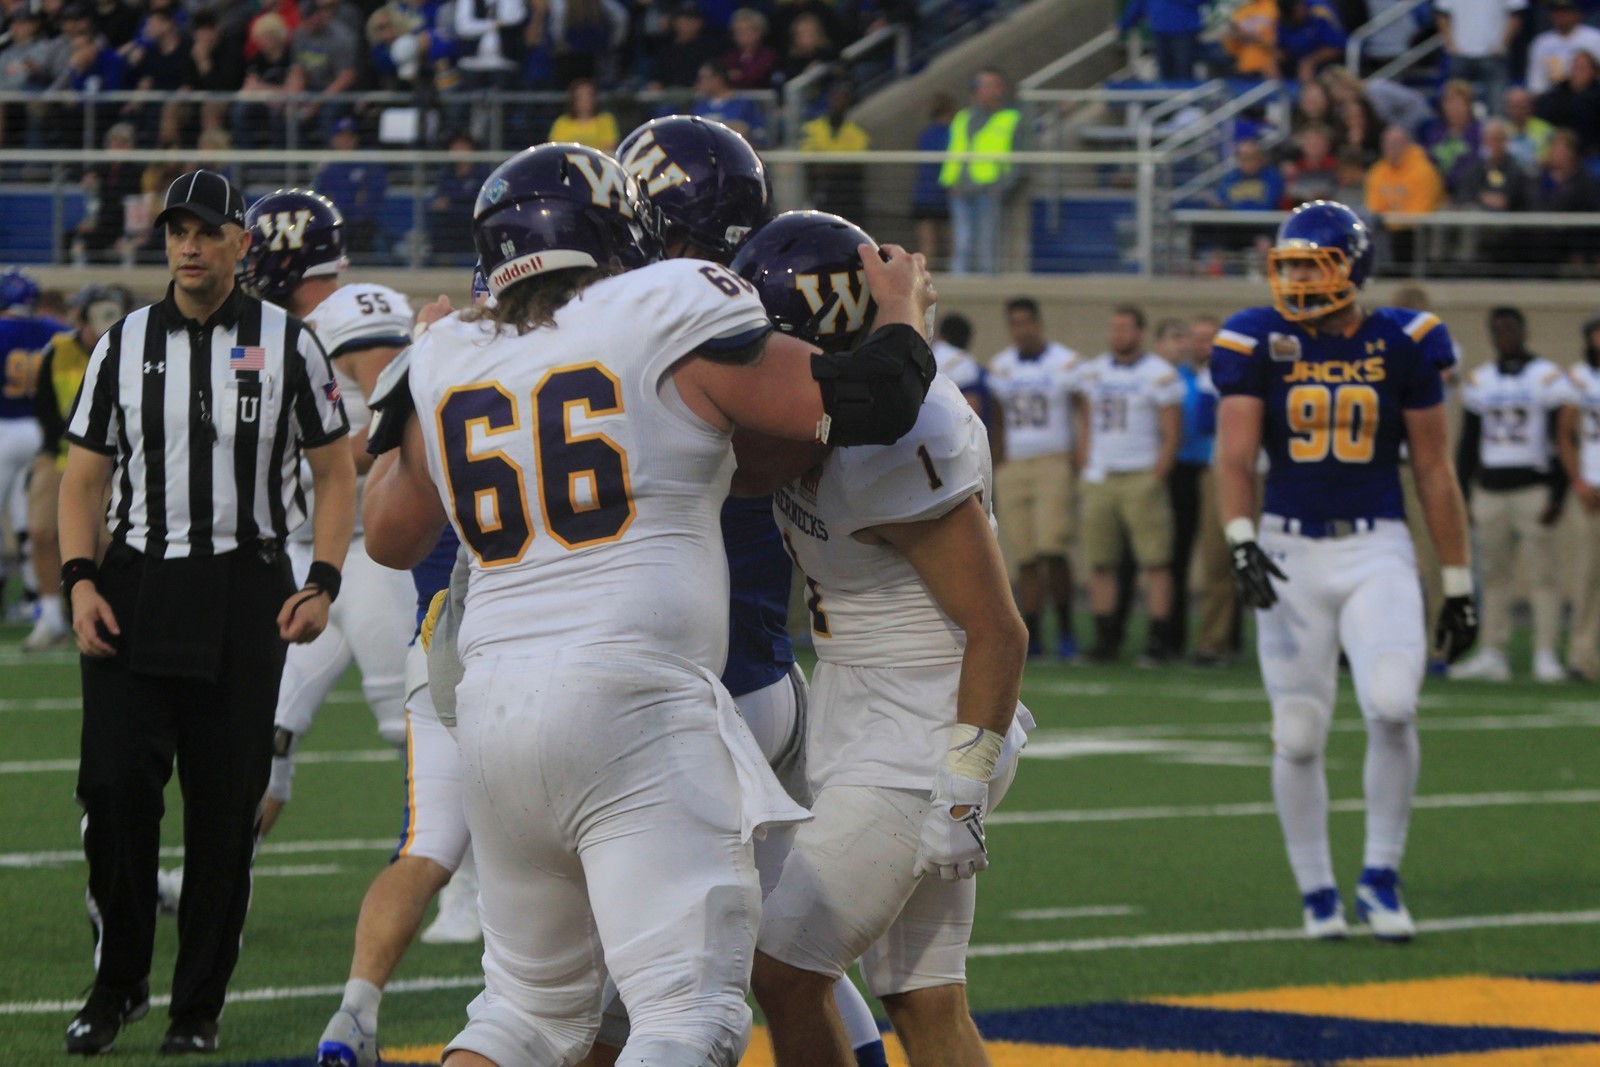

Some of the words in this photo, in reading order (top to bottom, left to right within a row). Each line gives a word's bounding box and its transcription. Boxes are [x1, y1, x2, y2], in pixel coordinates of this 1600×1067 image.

[256, 210, 312, 251] W
[355, 292, 391, 316] 55
[795, 269, 872, 335] W
[1284, 357, 1387, 383] JACKS
[240, 396, 260, 424] U
[1286, 384, 1379, 463] 90
[435, 360, 637, 568] 66
[916, 442, 945, 493] 1
